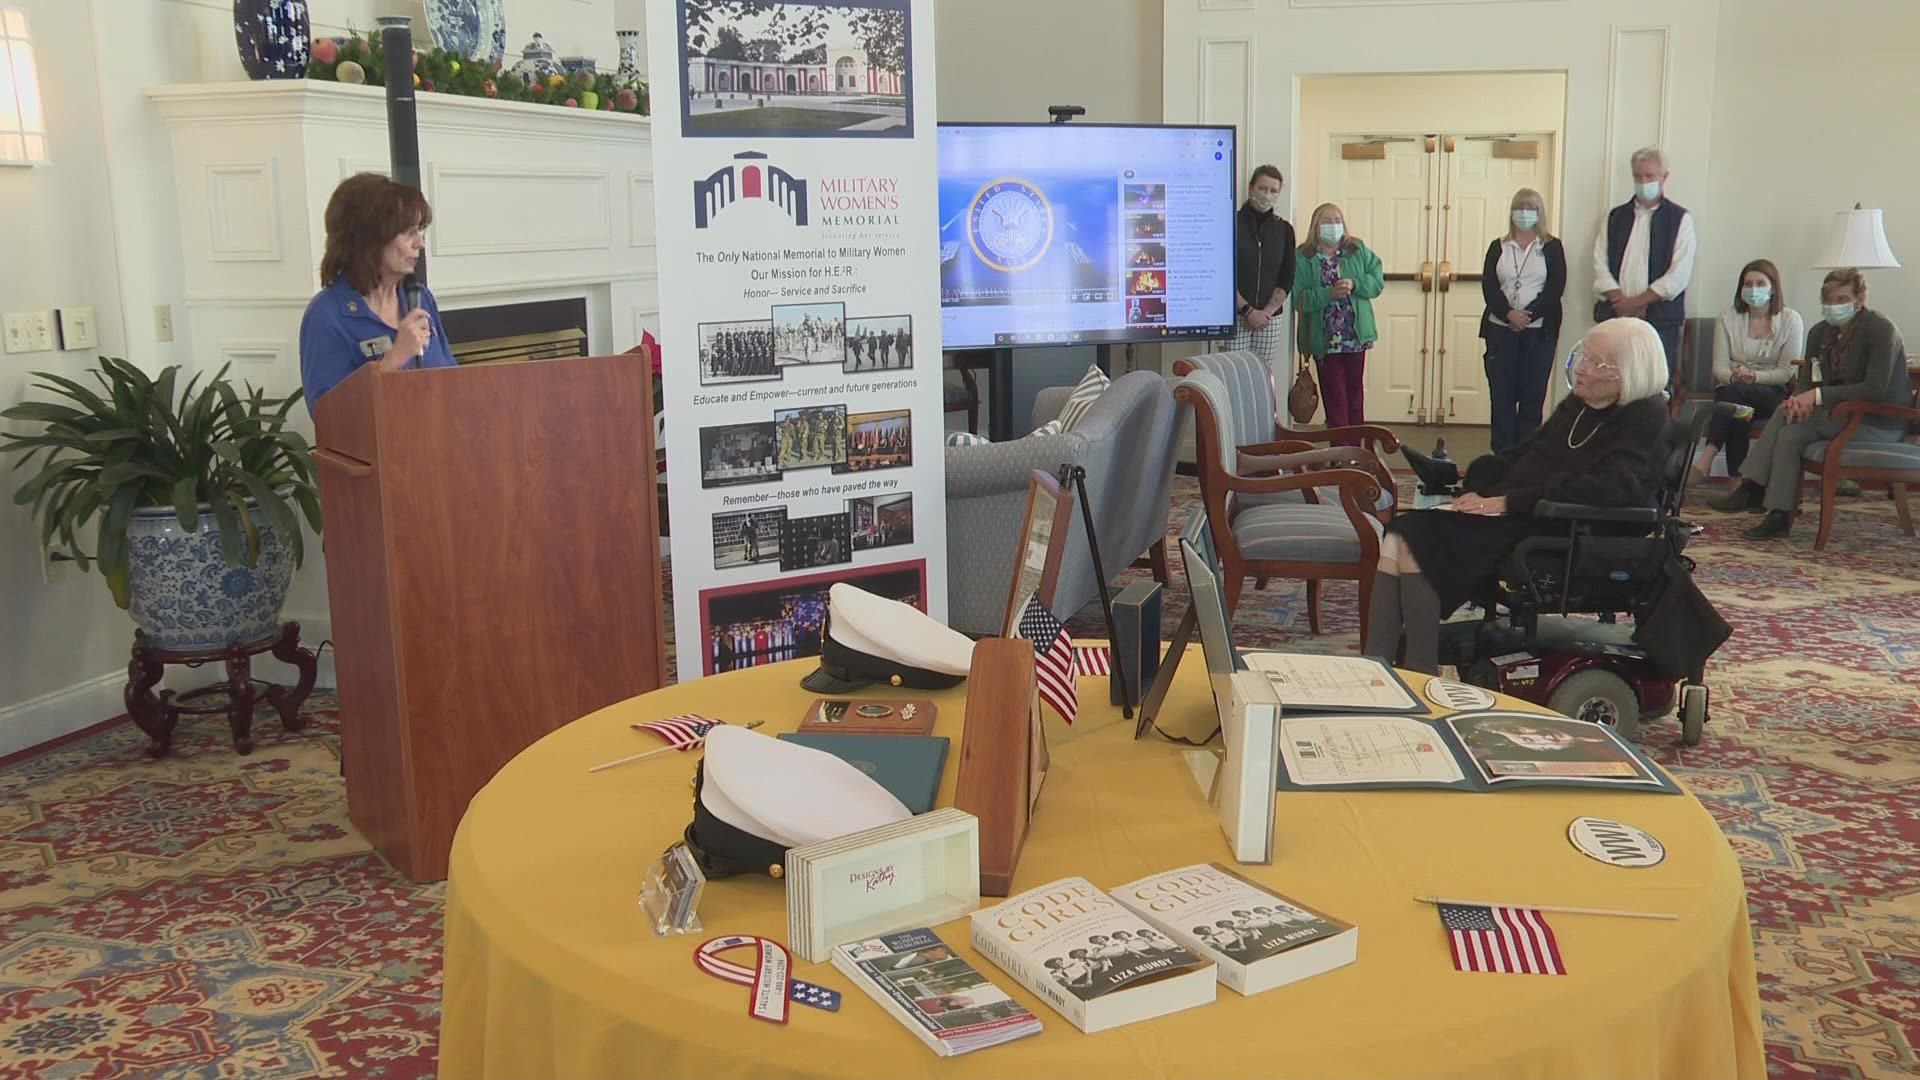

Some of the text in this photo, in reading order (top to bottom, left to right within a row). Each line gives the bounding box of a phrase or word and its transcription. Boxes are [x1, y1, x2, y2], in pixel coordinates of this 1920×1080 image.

[820, 178, 898, 193] MILITARY
[820, 195, 899, 210] WOMEN'S
[821, 215, 899, 226] MEMORIAL
[696, 246, 906, 264] The Only National Memorial to Military Women
[751, 269, 768, 280] Our
[771, 268, 807, 279] Mission
[809, 267, 822, 278] for
[781, 286, 812, 296] Service
[814, 285, 829, 295] and
[831, 283, 867, 295] Sacrifice
[693, 394, 729, 405] Educate
[731, 391, 747, 401] and
[829, 384, 845, 394] and
[846, 382, 870, 393] future
[871, 378, 918, 392] generations
[802, 487, 819, 497] who
[821, 485, 841, 495] have
[843, 481, 867, 494] paved
[868, 480, 882, 489] the
[883, 478, 899, 488] way
[1583, 819, 1647, 861] WWII
[850, 867, 884, 883] DESIGNS
[866, 868, 896, 893] Kathy
[1135, 871, 1225, 900] CODE
[997, 884, 1095, 929] CODE
[1150, 880, 1246, 912] GIRLS
[1008, 896, 1115, 942] GIRLS
[1262, 927, 1319, 950] LIZA MUNDY
[763, 944, 773, 963] WOMEN
[761, 964, 773, 988] MILITARY
[974, 932, 1066, 1008] CODE GIRLS LIZA MUNDY
[1109, 957, 1173, 983] LIZA MUNDY
[758, 988, 770, 1010] SALUTE
